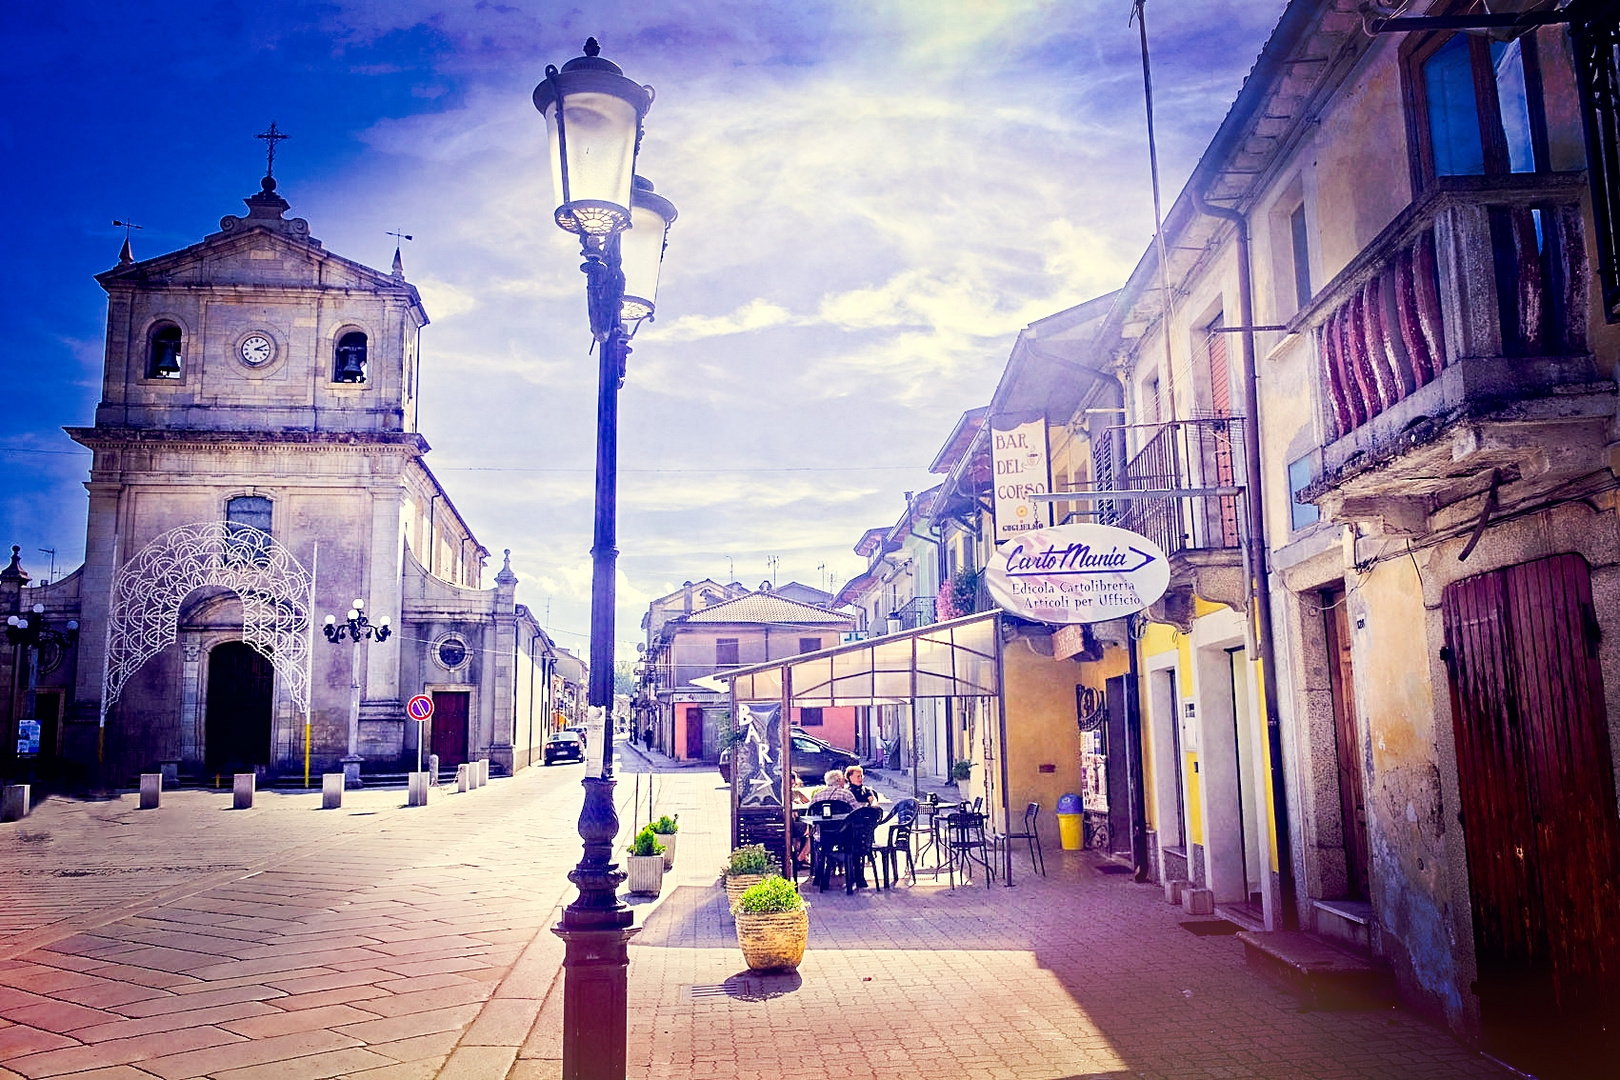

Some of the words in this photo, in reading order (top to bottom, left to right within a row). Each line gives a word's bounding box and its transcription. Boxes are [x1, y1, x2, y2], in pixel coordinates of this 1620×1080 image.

[996, 433, 1028, 450] BAR
[997, 459, 1024, 475] DEL
[998, 483, 1045, 500] CORSO
[1012, 580, 1055, 595] Edicola
[1060, 579, 1135, 593] Cartolibreria
[1024, 596, 1069, 609] Articoli
[1075, 598, 1093, 610] per
[1098, 593, 1140, 606] Ufficio
[739, 703, 774, 767] BAR
